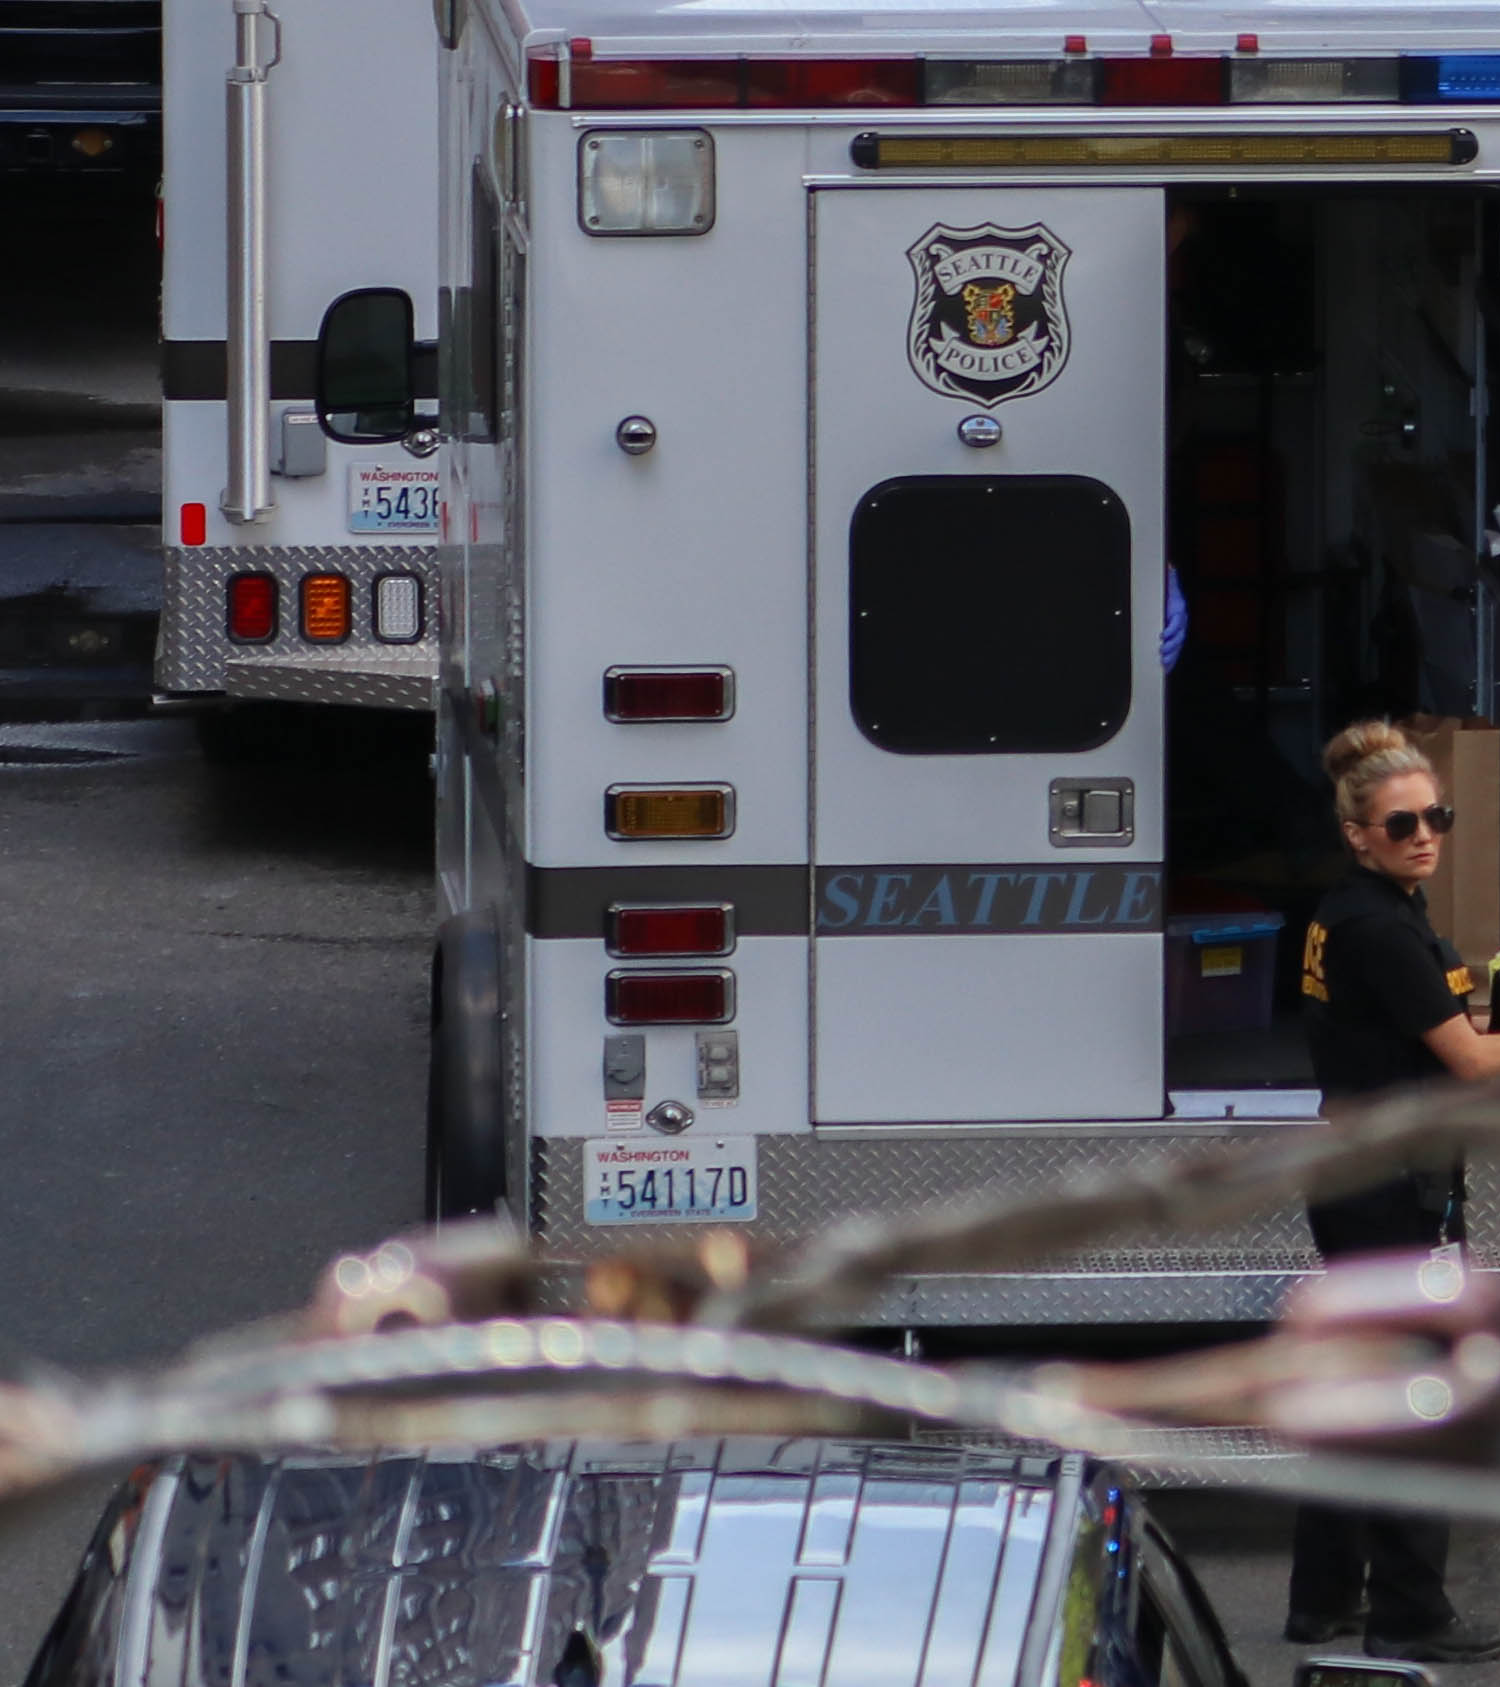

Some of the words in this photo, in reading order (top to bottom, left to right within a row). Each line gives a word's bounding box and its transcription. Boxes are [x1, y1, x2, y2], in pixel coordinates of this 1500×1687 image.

[940, 254, 1037, 283] SEATTLE
[945, 346, 1037, 373] POLICE
[360, 472, 439, 483] WASHINGTON
[816, 873, 1161, 928] SEATTLE
[596, 1150, 690, 1163] WASHINGTON
[616, 1167, 748, 1209] 54117D
